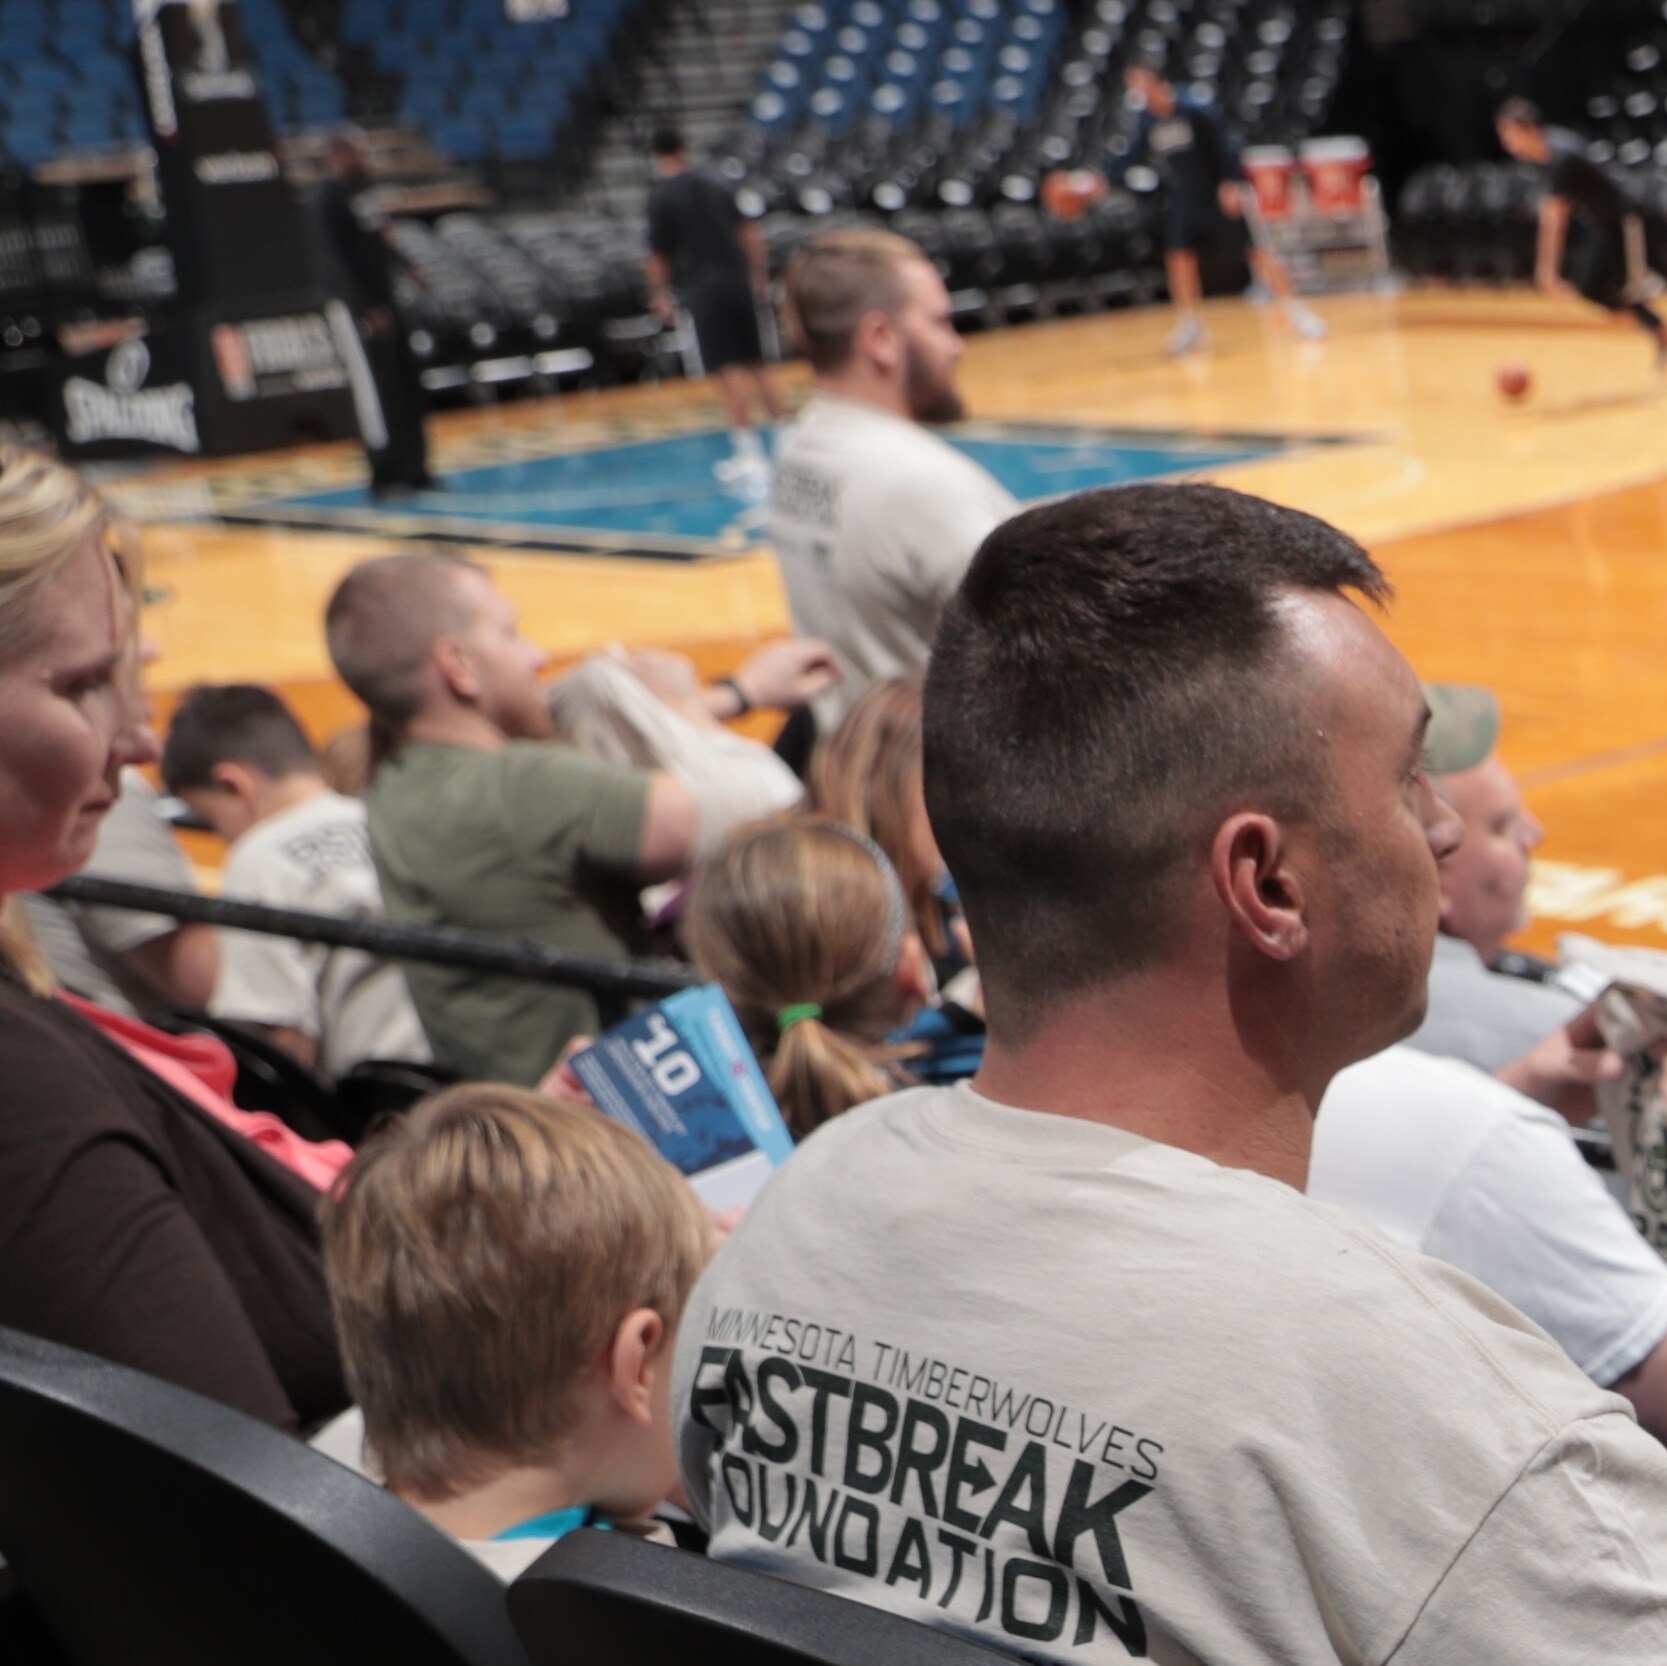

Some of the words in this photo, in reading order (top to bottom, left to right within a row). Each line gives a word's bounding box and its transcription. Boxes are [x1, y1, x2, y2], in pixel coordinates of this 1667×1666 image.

[690, 1345, 1156, 1592] FASTBREAK
[705, 1305, 857, 1374] MINNESOTA
[872, 1340, 1165, 1481] TIMBERWOLVES
[712, 1451, 1148, 1658] OUNDATION
